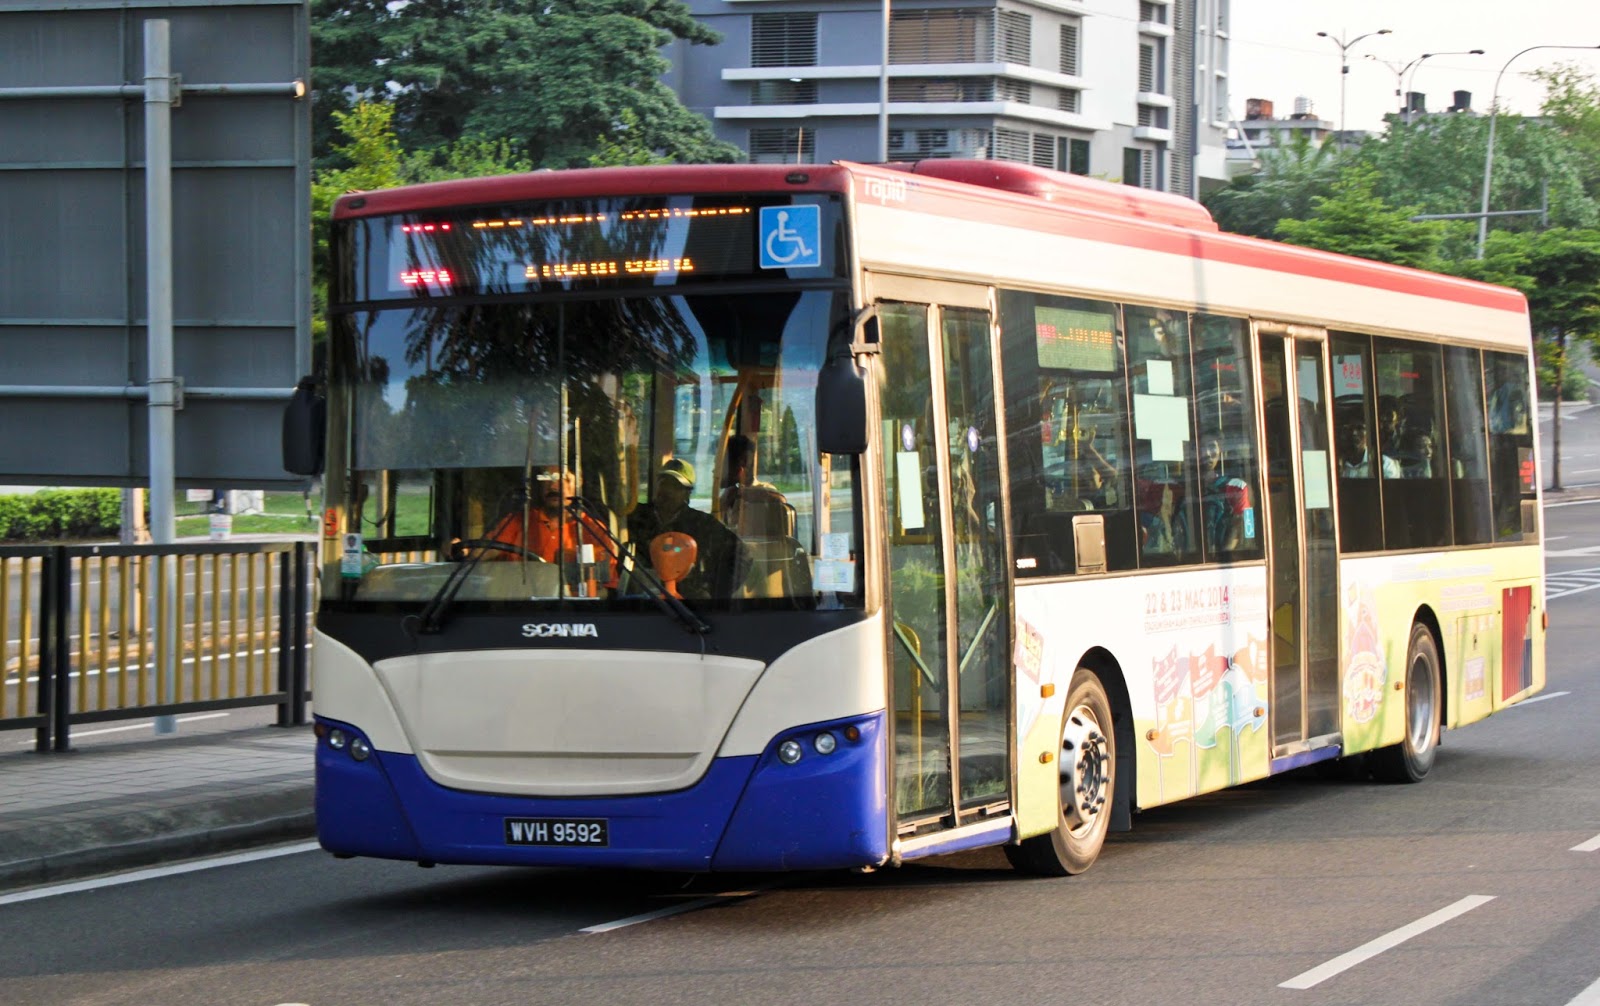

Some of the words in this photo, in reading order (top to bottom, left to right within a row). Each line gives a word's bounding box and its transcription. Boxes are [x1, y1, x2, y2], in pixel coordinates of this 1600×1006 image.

[864, 175, 906, 206] rapid
[1207, 585, 1229, 608] 2014
[521, 623, 599, 638] SCANIA
[510, 822, 548, 841] WVH
[553, 823, 602, 843] 9592
